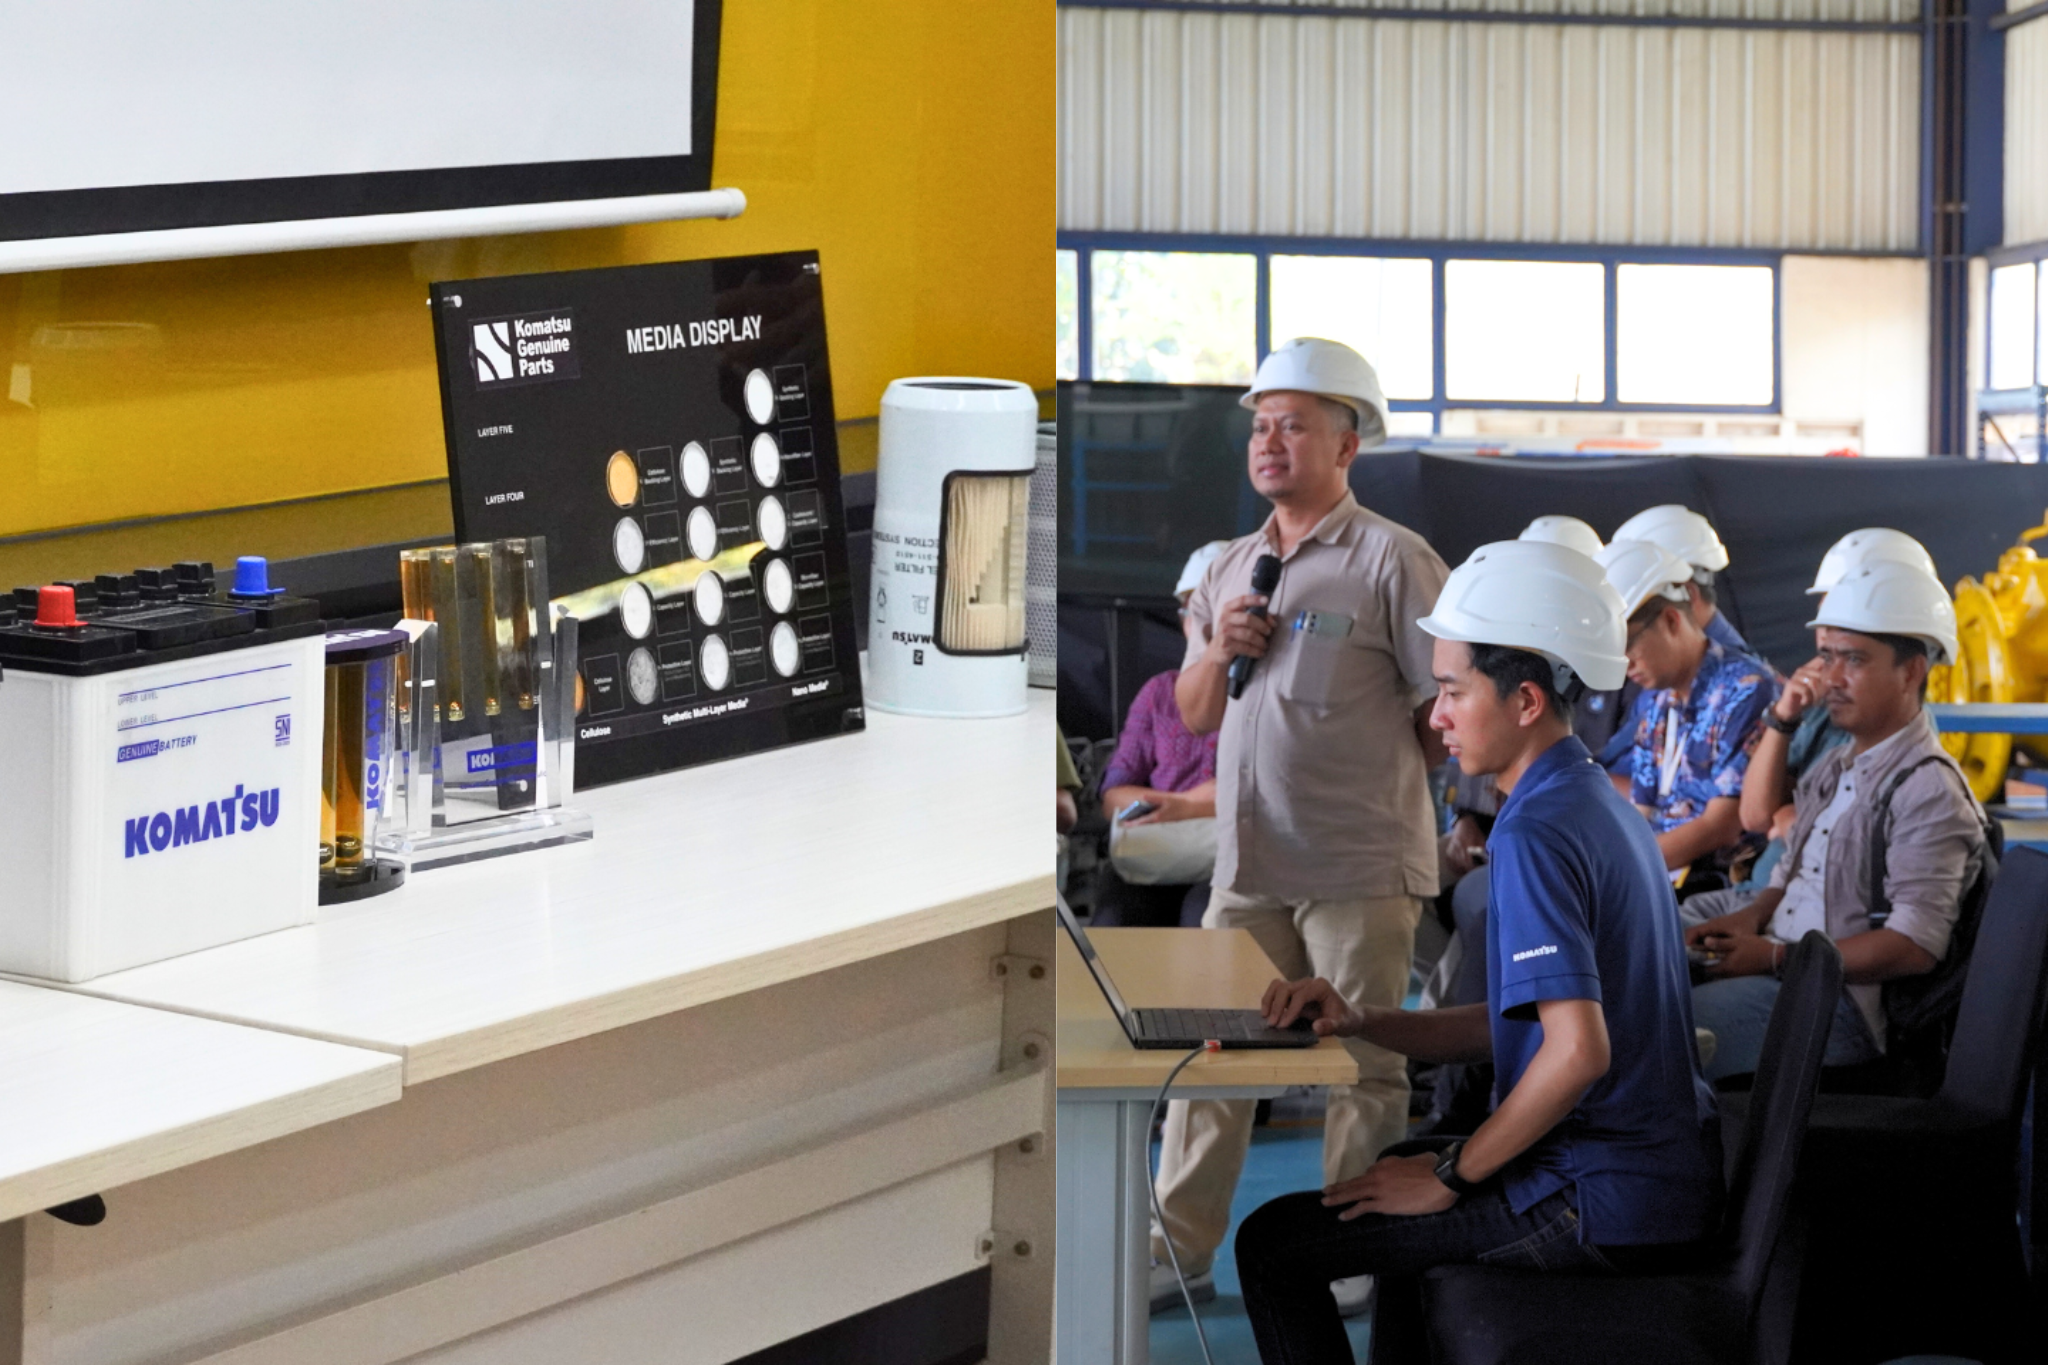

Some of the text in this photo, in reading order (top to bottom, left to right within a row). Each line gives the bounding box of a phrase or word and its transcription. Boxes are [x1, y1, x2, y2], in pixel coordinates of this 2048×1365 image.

[514, 316, 572, 337] Komatsu
[627, 315, 762, 354] MEDIA DISPLAY
[516, 336, 570, 357] Genuine
[519, 356, 554, 377] Parts
[477, 424, 514, 438] LAYER FIVE
[485, 491, 525, 506] LAYER FOUR
[895, 562, 925, 575] FILTER
[117, 690, 158, 706] UPPER LEVEL
[791, 686, 808, 697] Nano
[117, 713, 158, 728] LOWER LEVEL
[662, 711, 692, 726] Synthetic
[693, 704, 727, 718] Multi-Layer
[275, 717, 291, 737] SNI
[580, 726, 611, 739] Cellulose
[118, 735, 198, 761] GENUINE BATTERY
[125, 783, 280, 859] KOMATSU
[1512, 945, 1558, 962] KOMATSU
